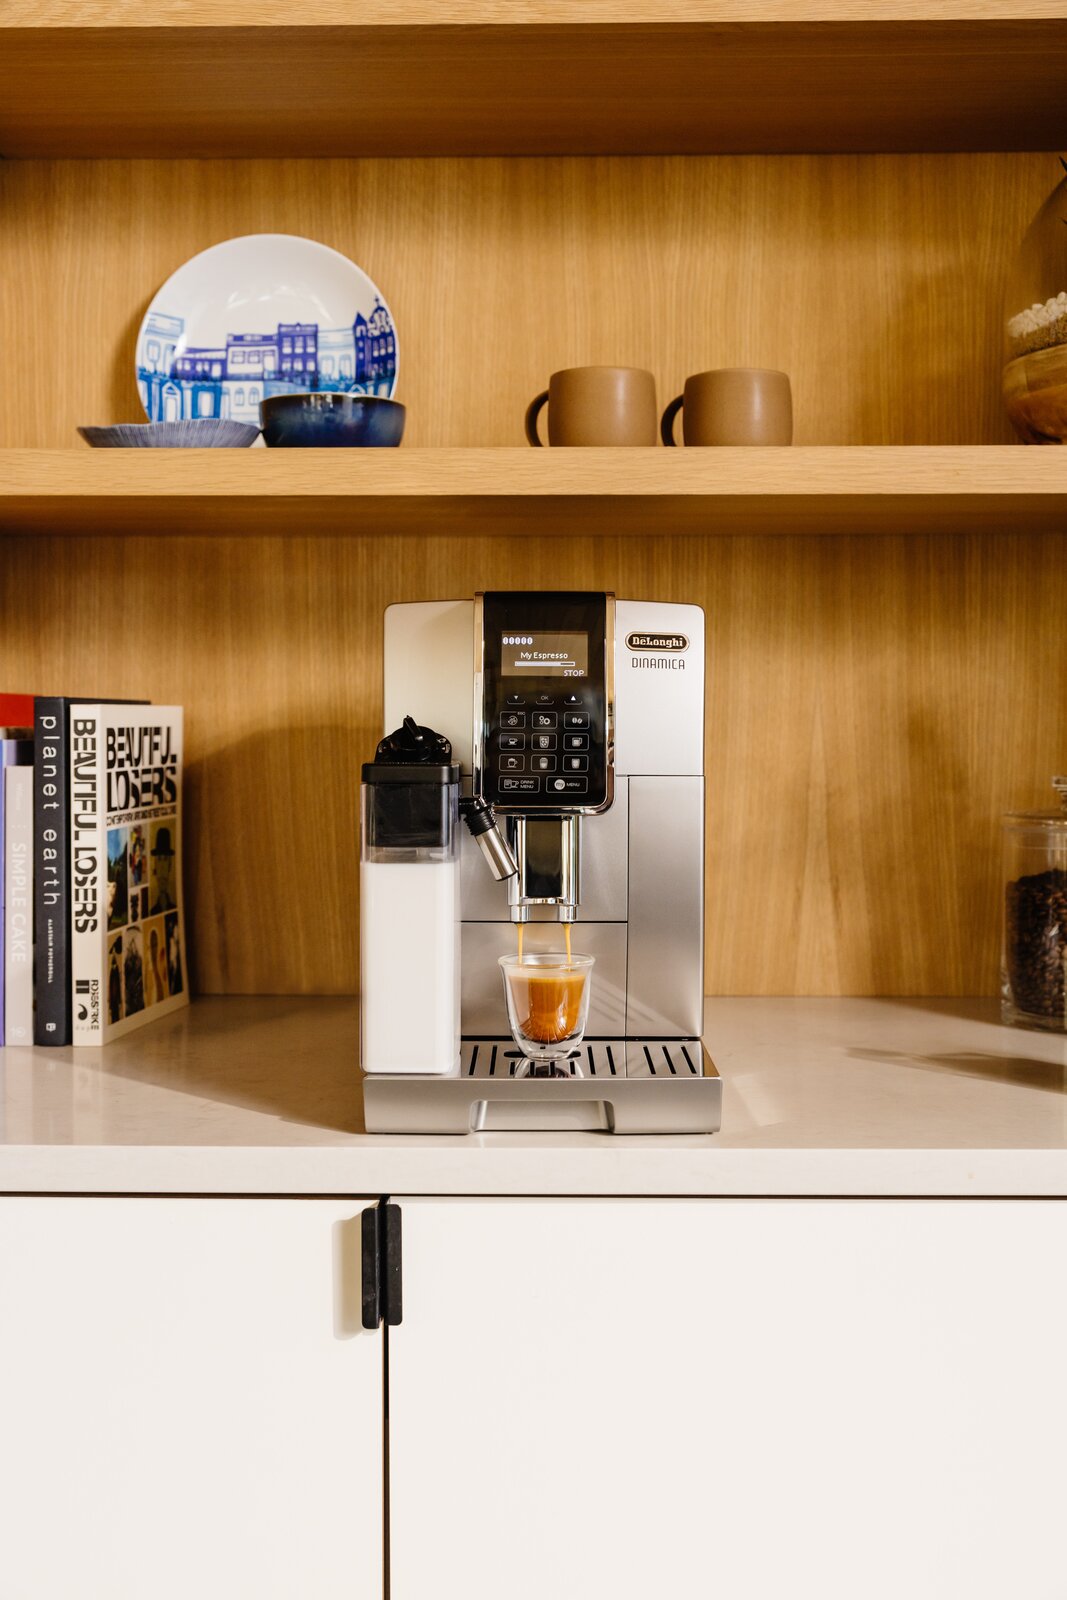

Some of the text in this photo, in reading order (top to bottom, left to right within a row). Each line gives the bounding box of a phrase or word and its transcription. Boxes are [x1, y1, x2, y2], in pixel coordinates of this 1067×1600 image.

[520, 652, 569, 660] My Espresso
[563, 669, 585, 677] STOP
[631, 657, 686, 670] DINAMICA
[106, 726, 177, 770] BEAUTIFUL
[39, 716, 61, 905] planet earth
[106, 765, 177, 813] LOSERS
[73, 718, 98, 934] BEAUTIFUL LOSERS
[11, 842, 27, 962] SIMPLE CAKE
